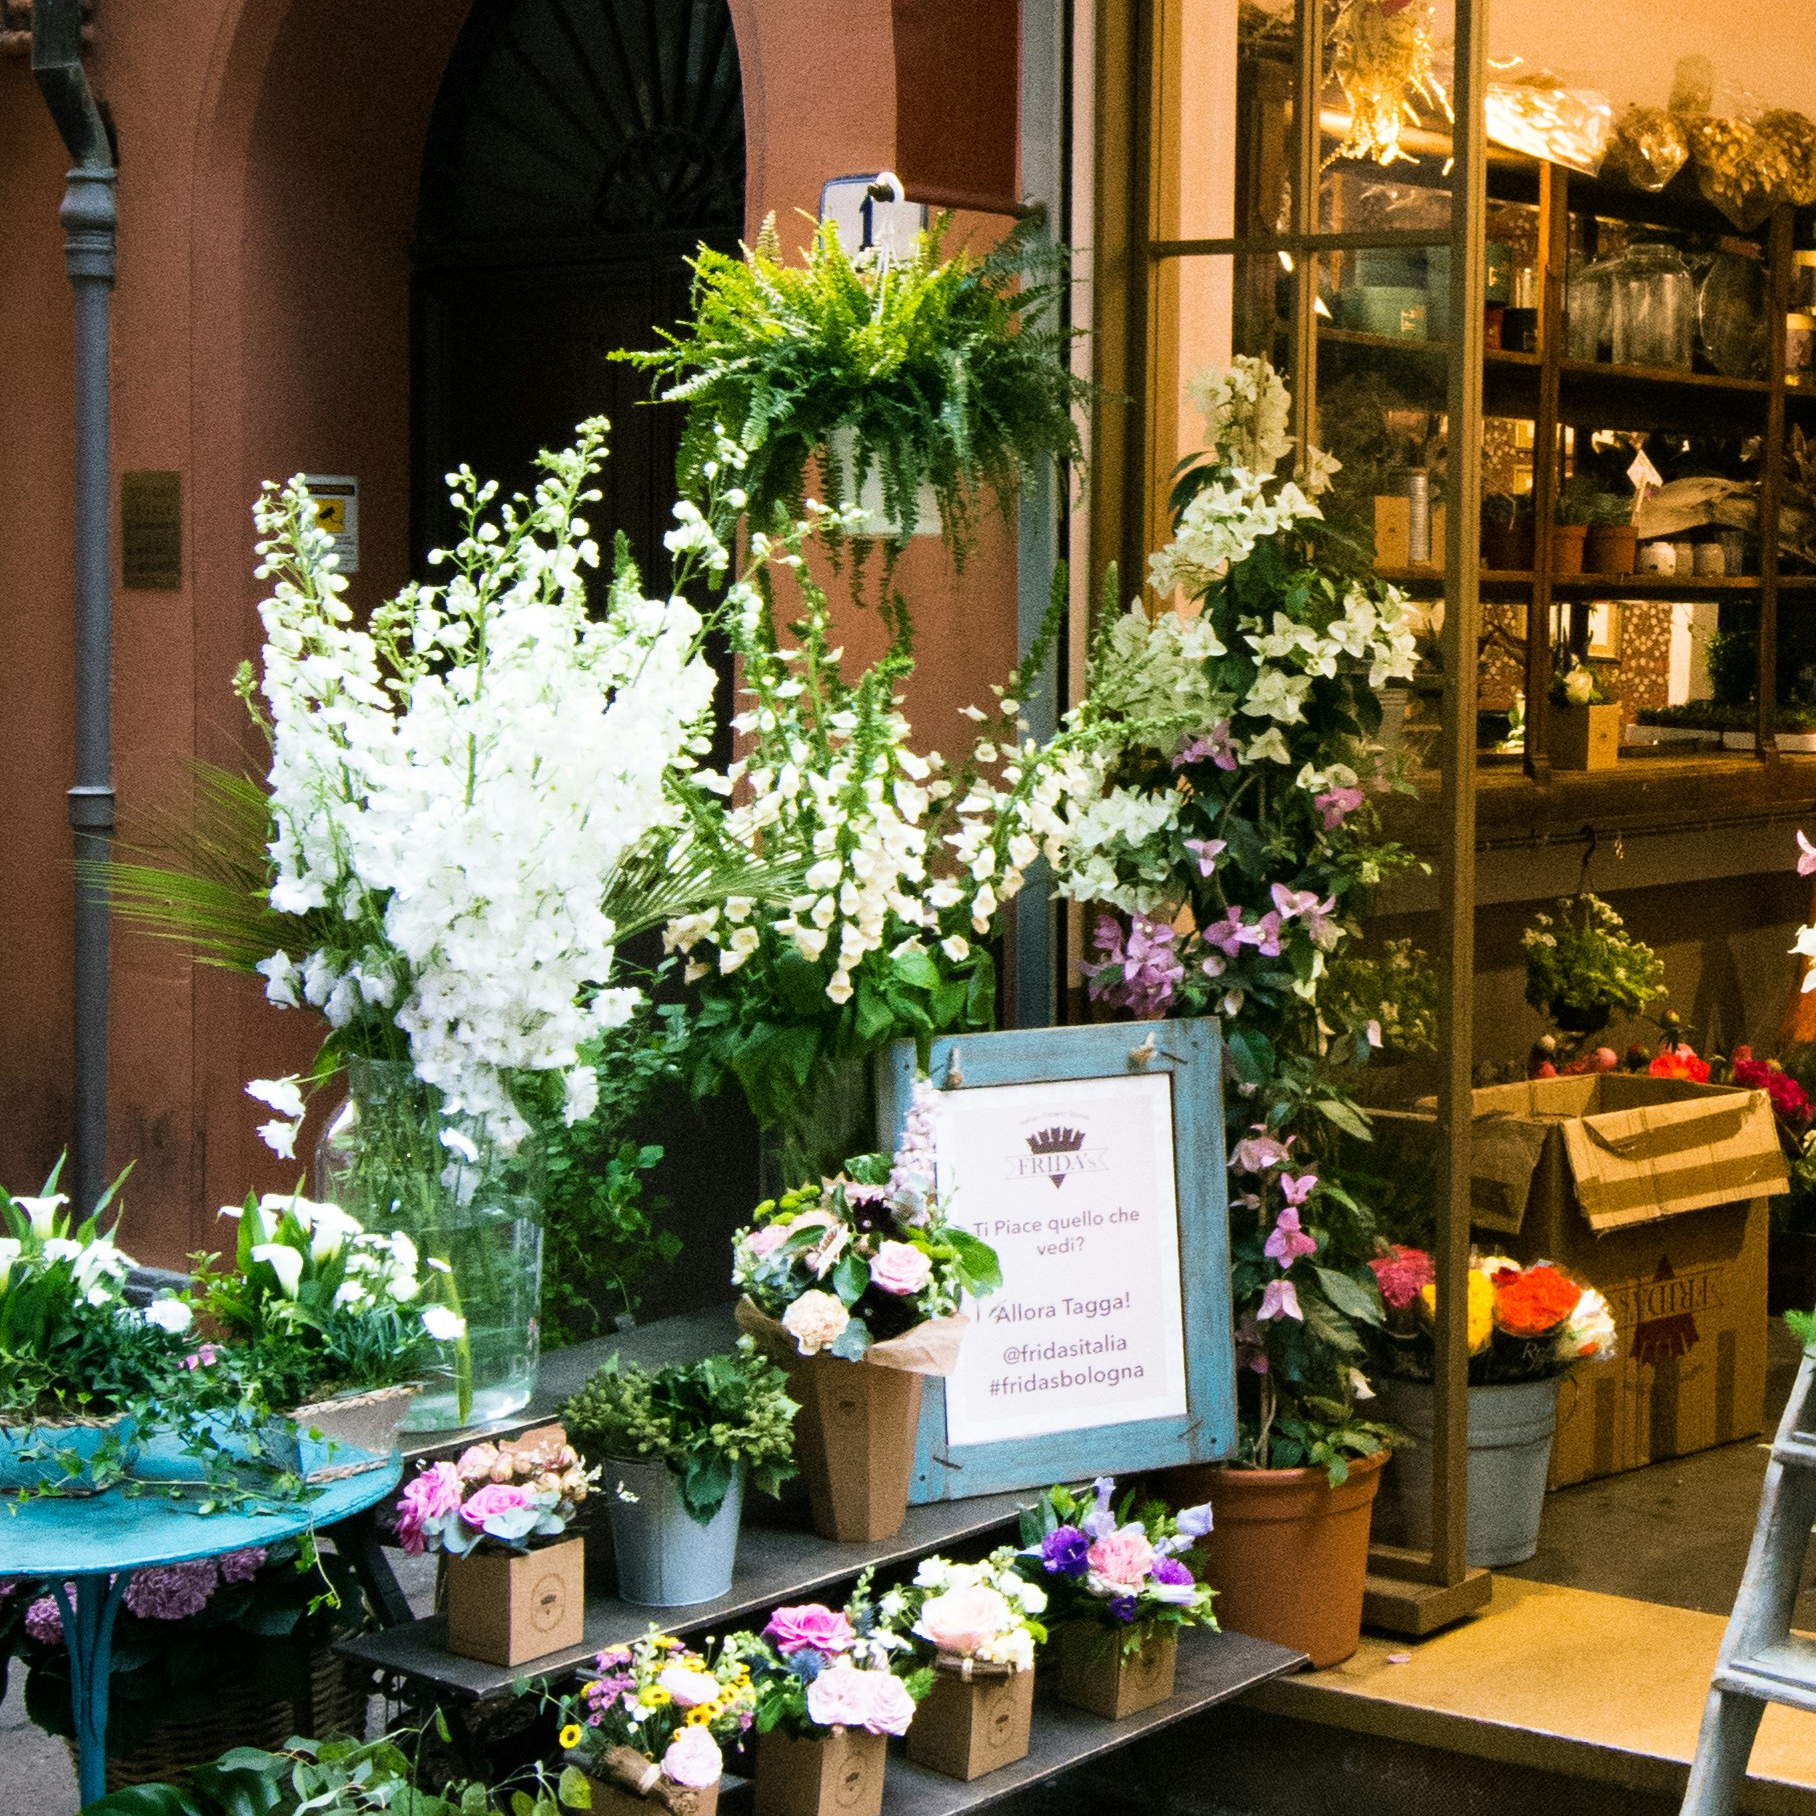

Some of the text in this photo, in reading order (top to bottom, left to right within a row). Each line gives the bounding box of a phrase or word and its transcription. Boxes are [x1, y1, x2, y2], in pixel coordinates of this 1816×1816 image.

[1018, 1152, 1097, 1176] FRIDA's
[973, 1206, 1140, 1237] Ti Piace quello che
[1037, 1236, 1085, 1256] vedi?
[997, 1291, 1131, 1323] Allora Tagga!
[1003, 1333, 1127, 1365] @fridasitalia
[989, 1364, 1144, 1396] #fridasbologna
